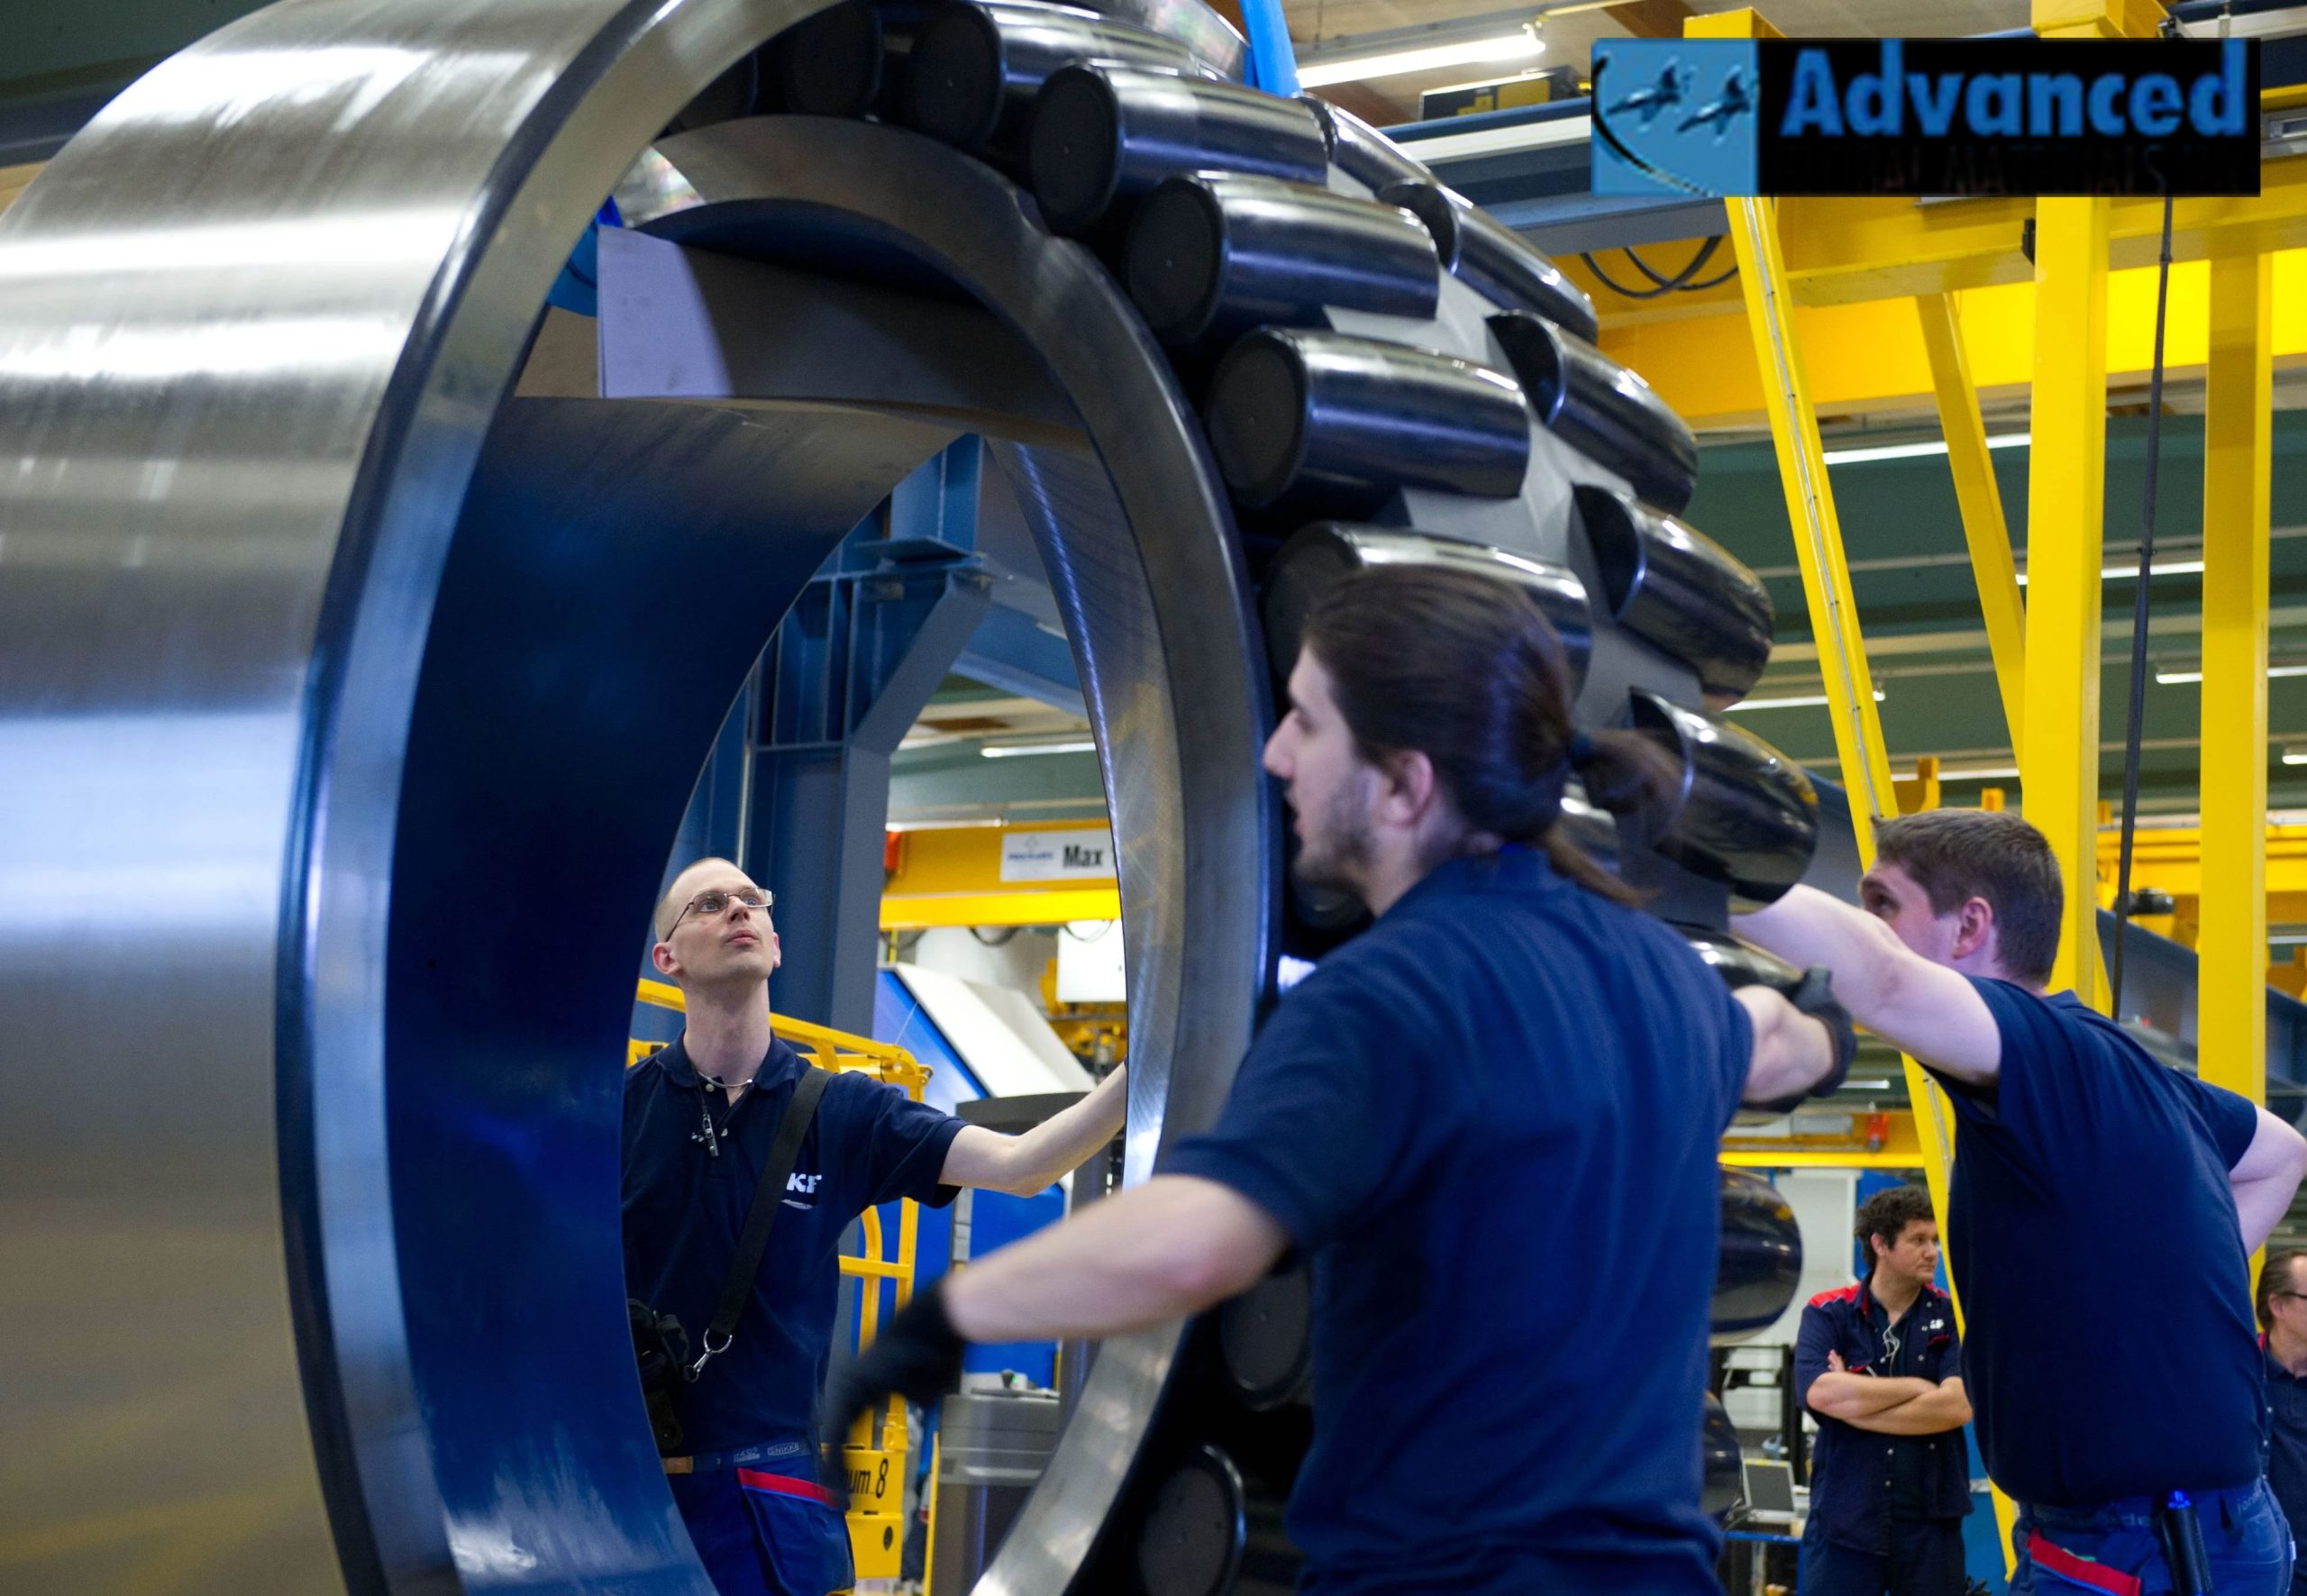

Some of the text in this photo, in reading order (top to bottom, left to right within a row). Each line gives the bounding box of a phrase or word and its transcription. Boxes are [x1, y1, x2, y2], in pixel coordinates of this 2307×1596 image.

[1063, 844, 1103, 868] Max
[786, 1172, 822, 1193] KF
[875, 1458, 889, 1500] 8
